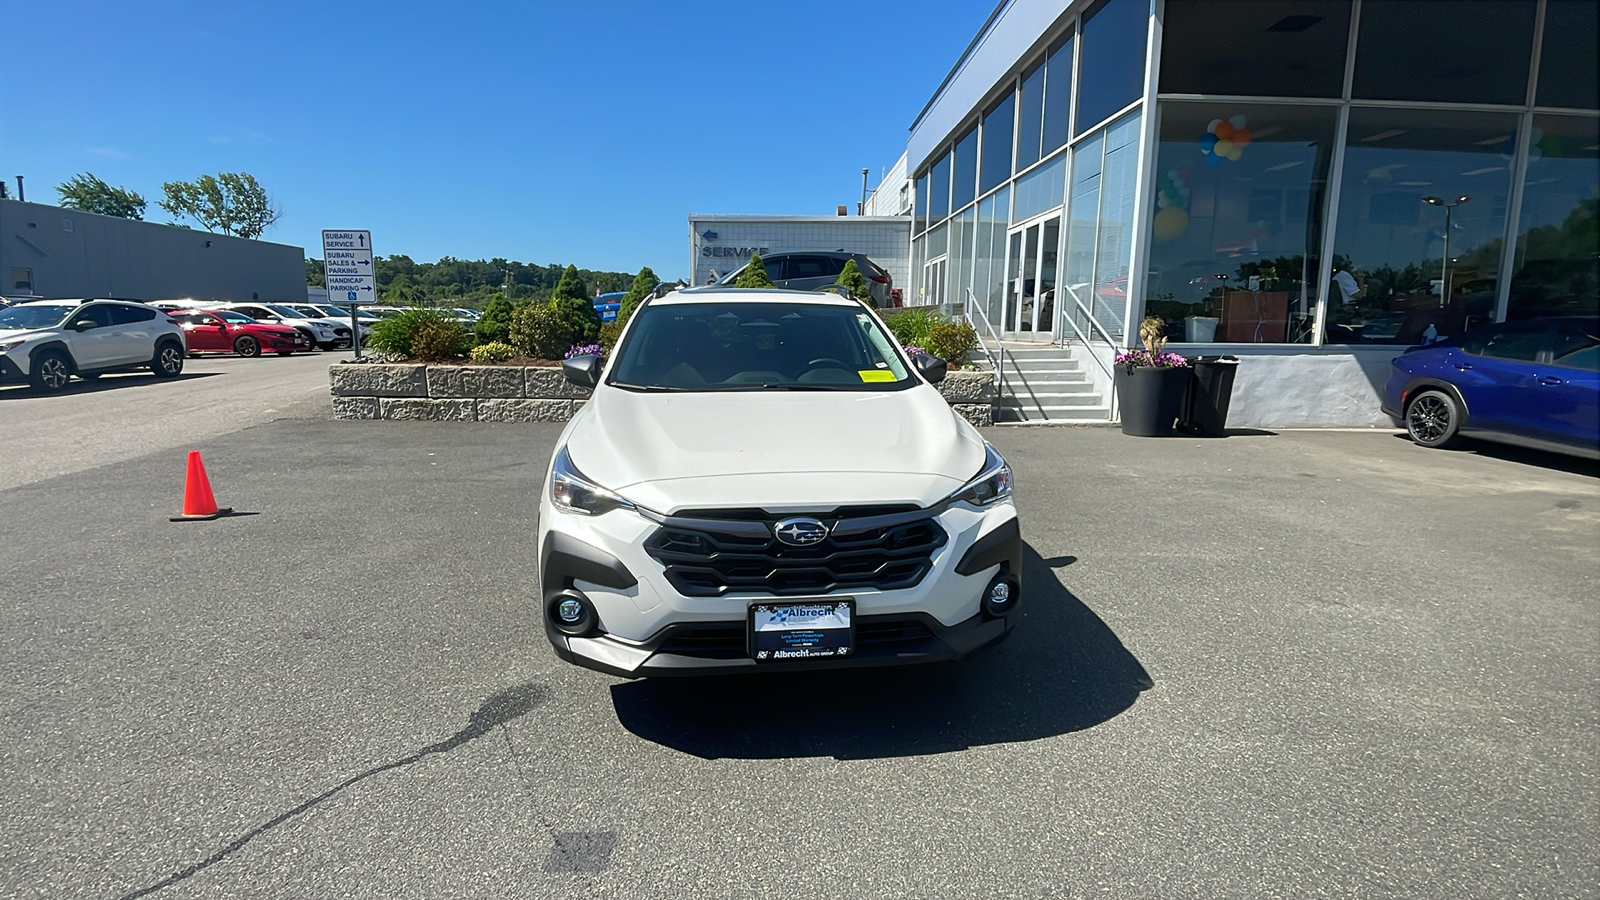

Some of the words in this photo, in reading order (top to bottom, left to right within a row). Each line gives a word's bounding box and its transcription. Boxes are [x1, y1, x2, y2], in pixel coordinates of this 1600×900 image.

[702, 246, 769, 258] SERVICE
[787, 608, 836, 617] Albrecht
[773, 649, 810, 659] Albrecht
